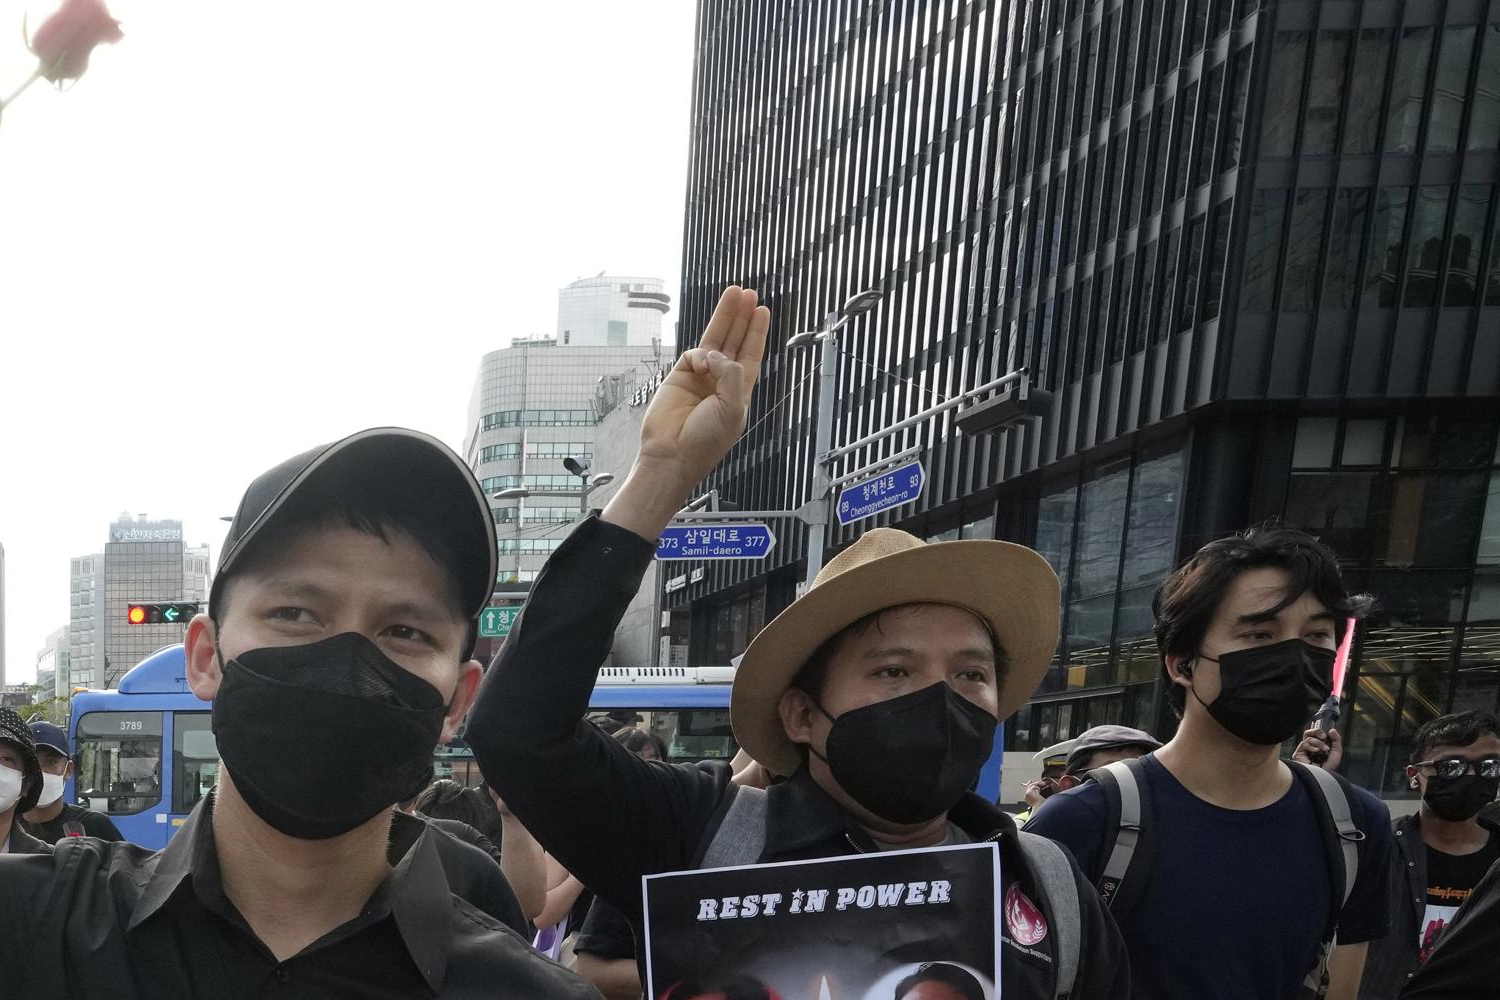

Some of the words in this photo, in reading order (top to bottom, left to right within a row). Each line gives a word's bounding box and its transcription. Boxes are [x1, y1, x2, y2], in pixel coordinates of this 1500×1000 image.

[909, 474, 919, 488] 93
[862, 476, 895, 501] 청계천로
[841, 501, 849, 513] 89
[850, 490, 909, 518] Cheonggyecheon-ro
[659, 537, 678, 549] 373
[685, 529, 741, 545] 삼일대로
[745, 536, 765, 547] 377
[681, 546, 742, 556] Samil-daero
[120, 720, 142, 730] 3789
[697, 892, 782, 922] REST
[836, 879, 952, 911] POWER
